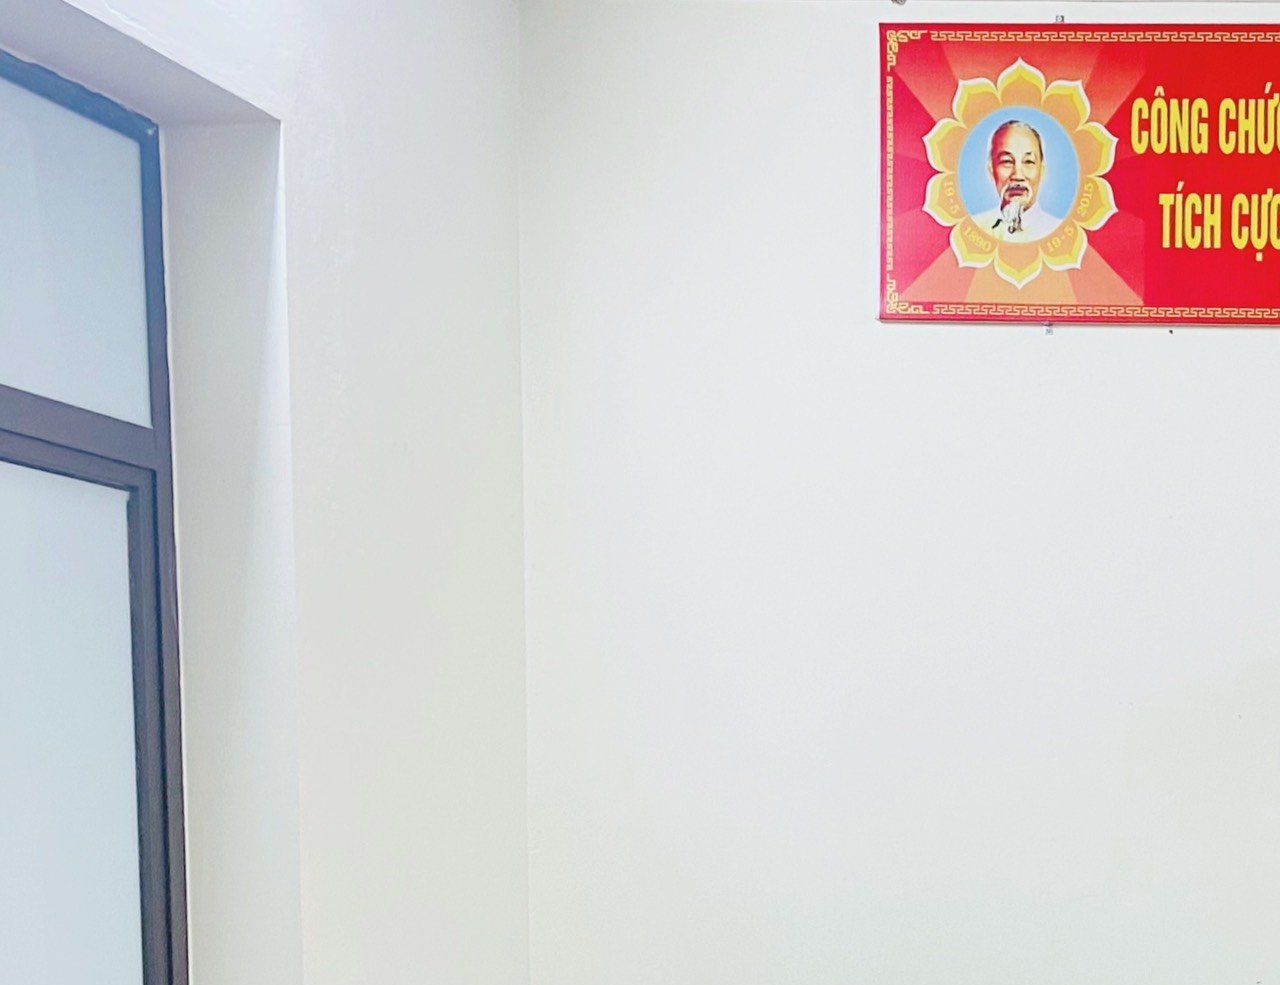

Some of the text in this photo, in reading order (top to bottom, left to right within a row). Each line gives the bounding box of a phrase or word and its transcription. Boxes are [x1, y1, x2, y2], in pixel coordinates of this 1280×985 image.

[1130, 86, 1209, 155] CÔNG
[1076, 182, 1094, 218] 2015
[1159, 181, 1222, 250] TÍCH
[963, 225, 993, 252] 1890
